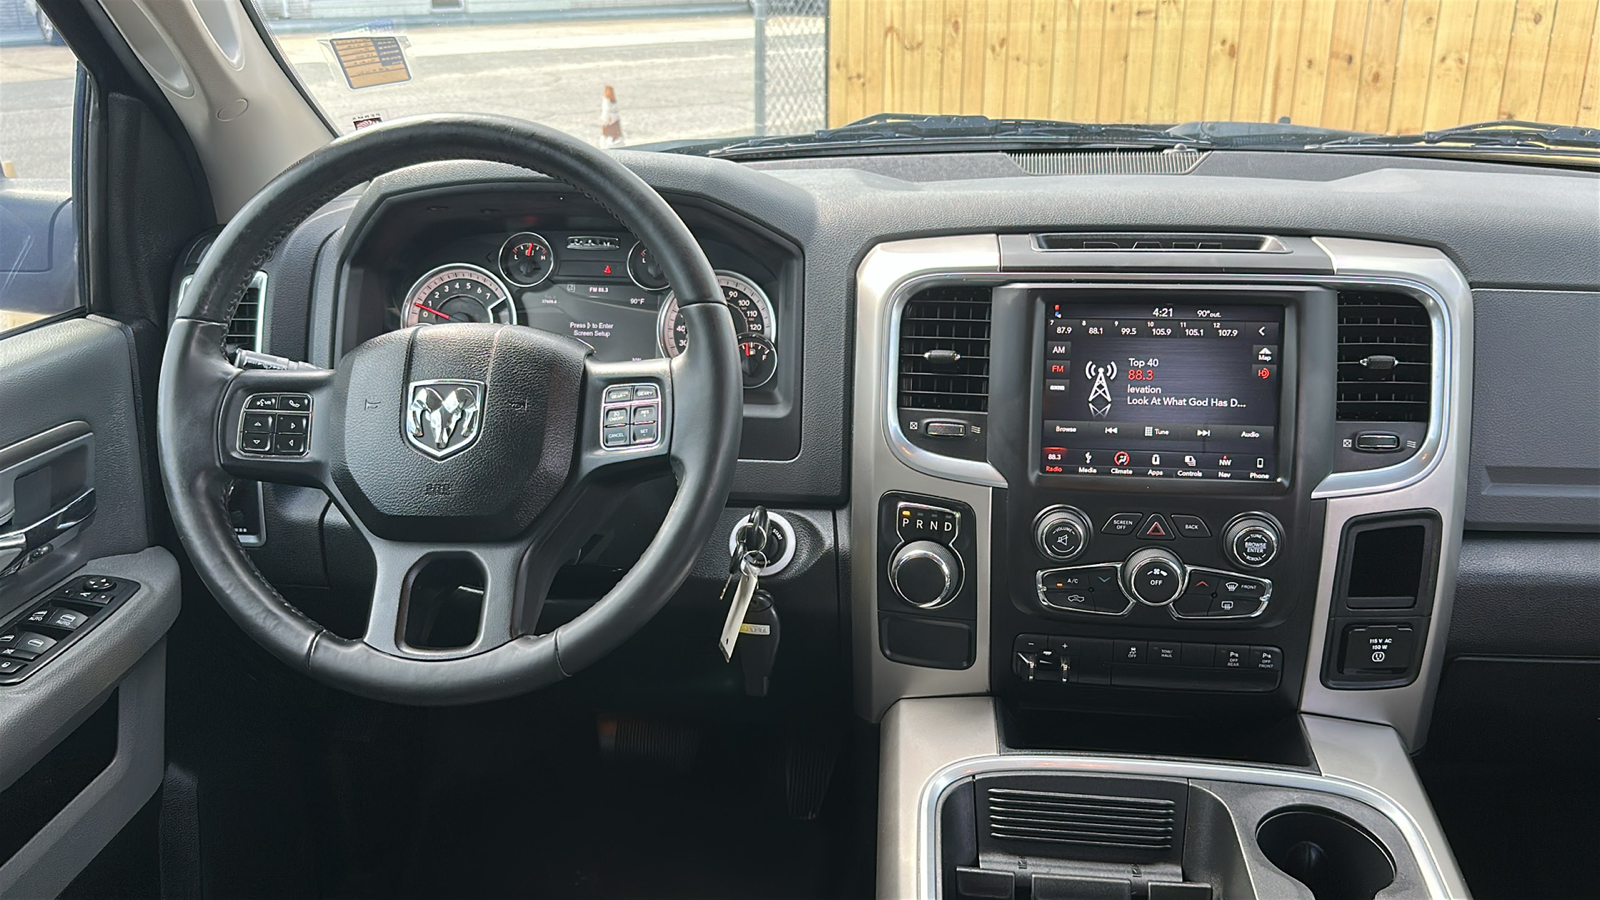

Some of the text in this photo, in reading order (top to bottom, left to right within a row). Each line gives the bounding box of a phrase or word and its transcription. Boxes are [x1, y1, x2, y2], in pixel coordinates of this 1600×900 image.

[1152, 308, 1173, 317] 4:21
[1152, 328, 1172, 336] 105.9
[1218, 329, 1238, 337] 107.9
[1052, 346, 1065, 354] AM
[1129, 358, 1159, 368] Top 40
[1128, 370, 1154, 380] 88.3
[1127, 396, 1149, 405] Look
[1150, 397, 1161, 405] At
[1163, 397, 1187, 406] What
[1189, 398, 1208, 407] God
[1211, 398, 1227, 407] Has
[1148, 469, 1163, 477] Apps
[903, 518, 952, 531] P R N D
[772, 529, 782, 540] START
